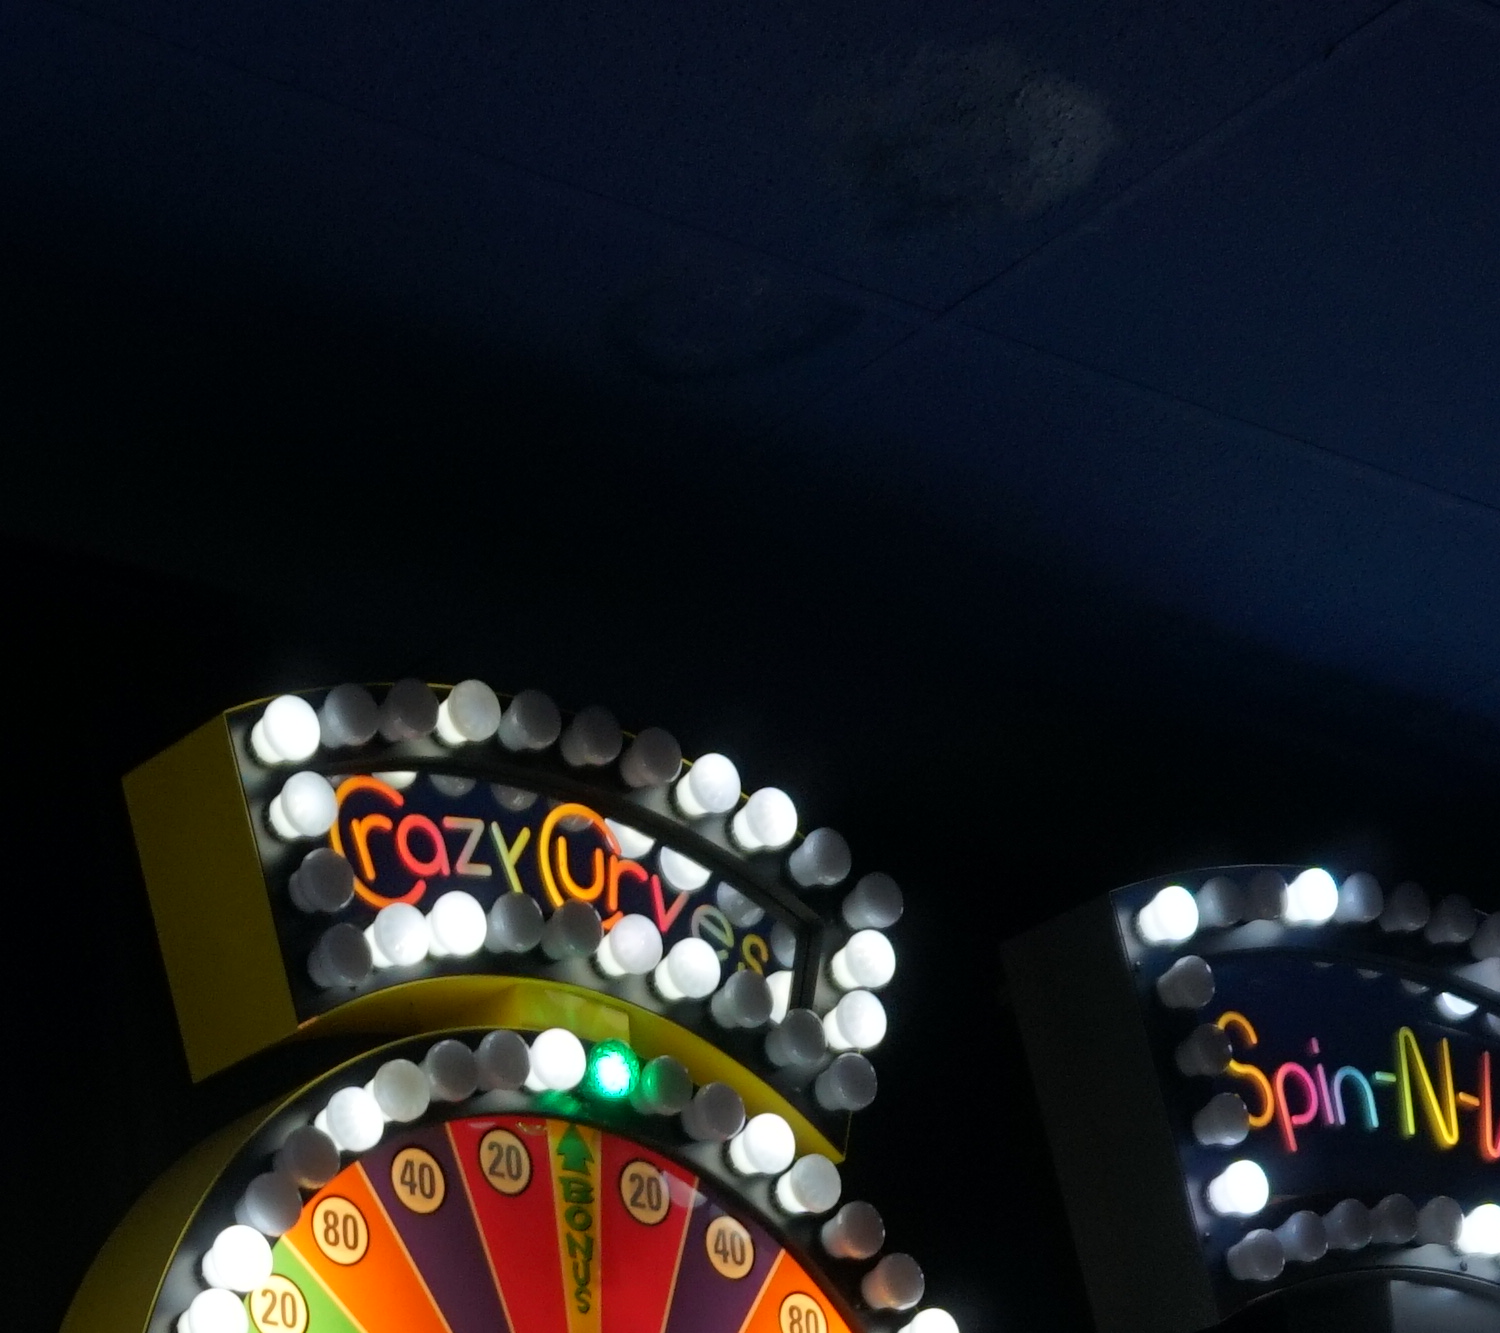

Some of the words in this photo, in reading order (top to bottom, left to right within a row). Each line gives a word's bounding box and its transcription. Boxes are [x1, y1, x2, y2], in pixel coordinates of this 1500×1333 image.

[401, 1159, 436, 1198] 40
[487, 1141, 523, 1180] 20
[629, 1173, 662, 1211] 20
[323, 1211, 359, 1250] 80
[560, 1177, 594, 1314] BONUS
[714, 1229, 745, 1266] 40
[261, 1289, 296, 1328] 20
